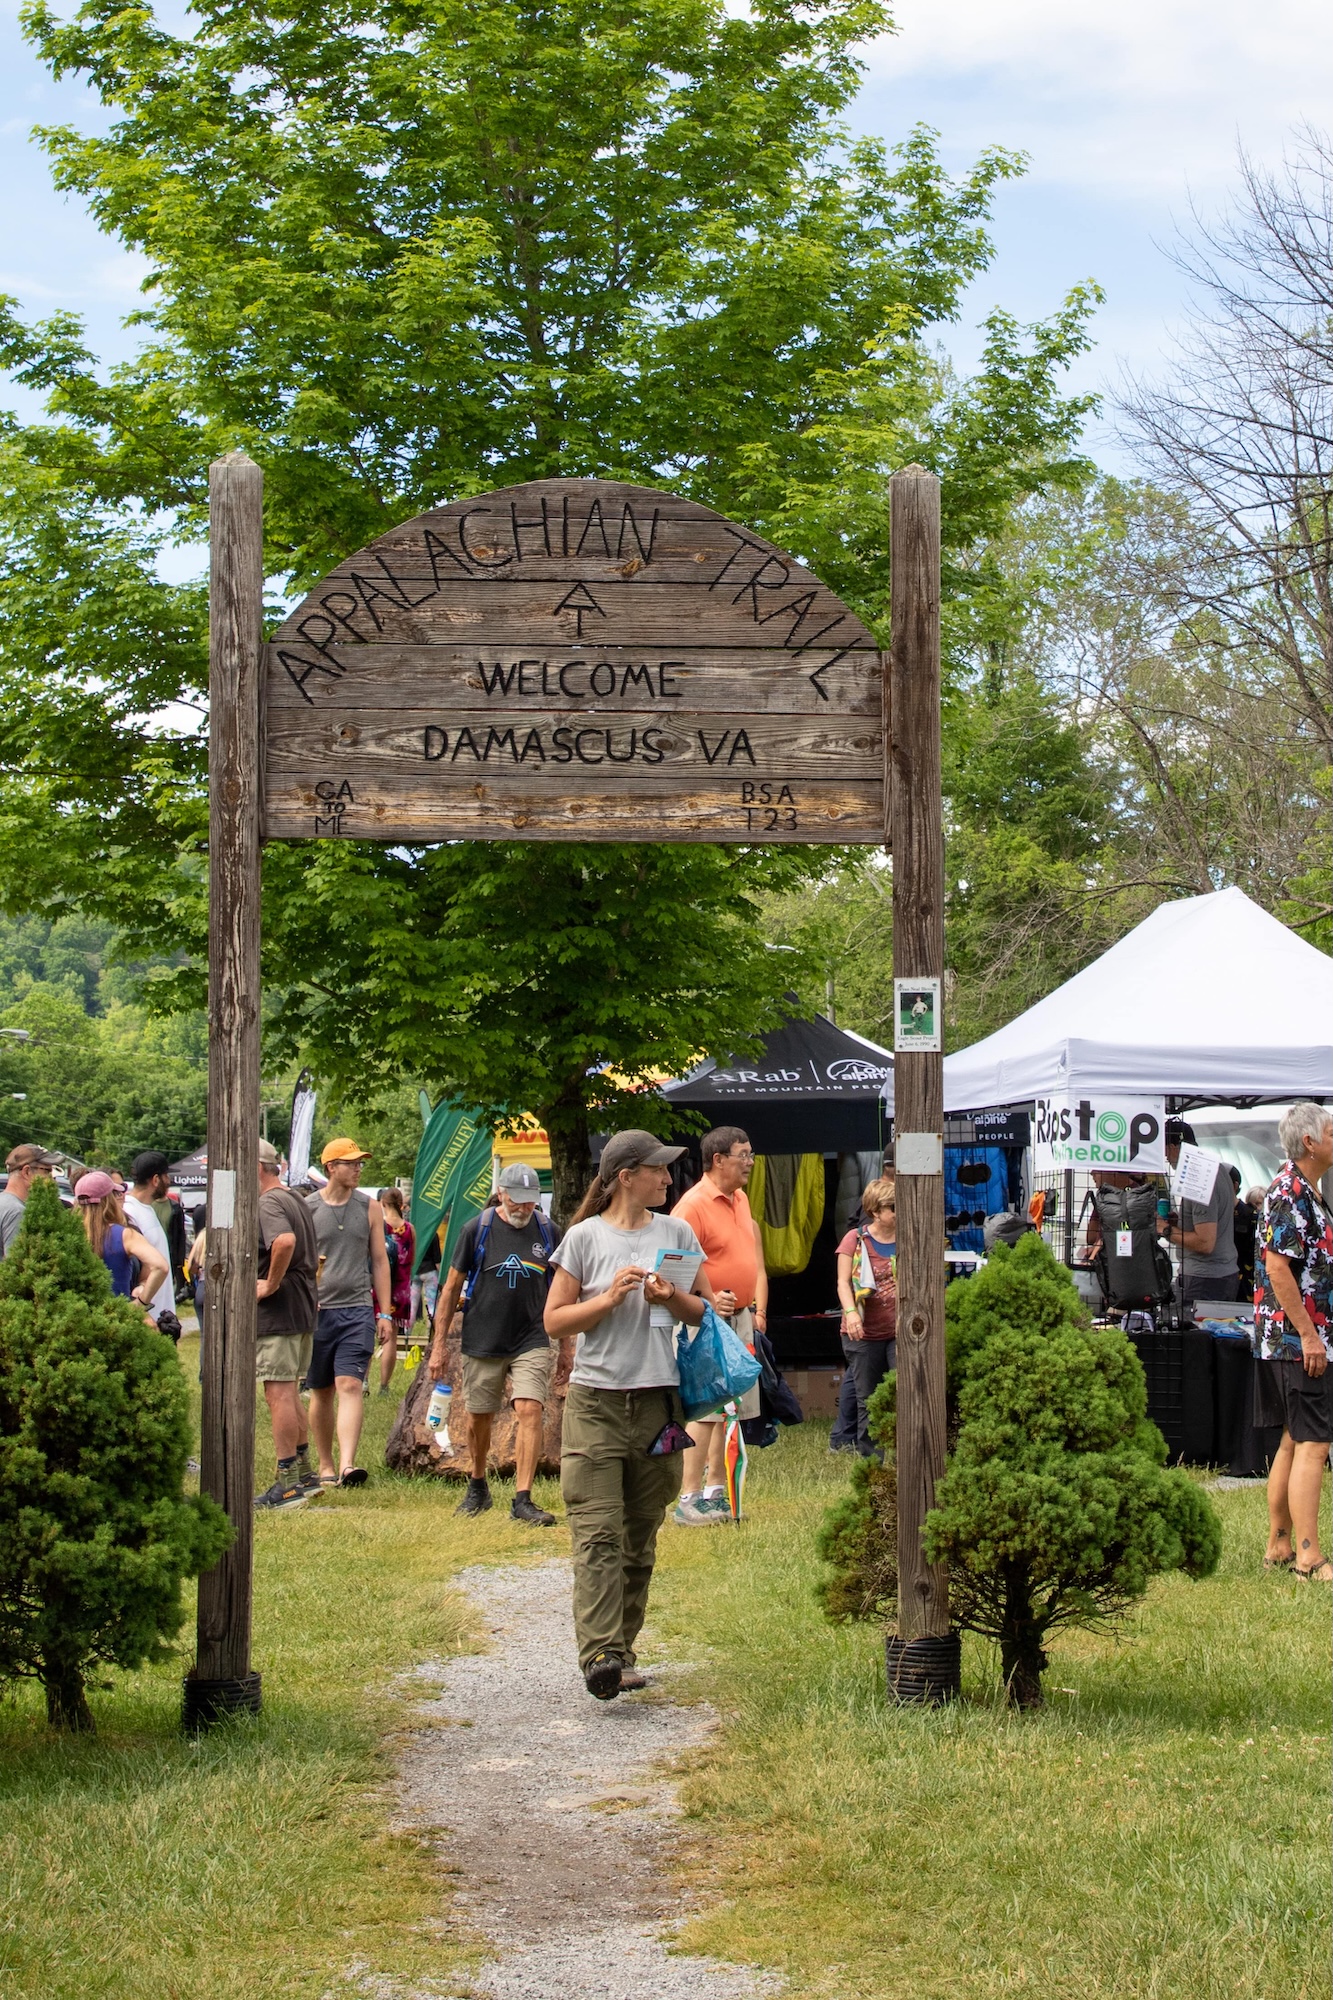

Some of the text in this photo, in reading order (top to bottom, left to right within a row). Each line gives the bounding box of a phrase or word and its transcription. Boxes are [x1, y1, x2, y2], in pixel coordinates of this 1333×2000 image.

[276, 496, 863, 705] APPALACHIAN TRAIL
[478, 660, 686, 698] WELCOME
[423, 725, 757, 766] DAMASCUS VA
[314, 779, 355, 802] GA
[741, 782, 795, 805] BSA
[314, 815, 353, 835] ME
[736, 1068, 801, 1083] Rab
[841, 1072, 888, 1082] alpin
[755, 1085, 843, 1093] MOUNTAIN
[1037, 1098, 1160, 1162] Ripstop
[424, 1121, 477, 1203] NATURE VALLEY
